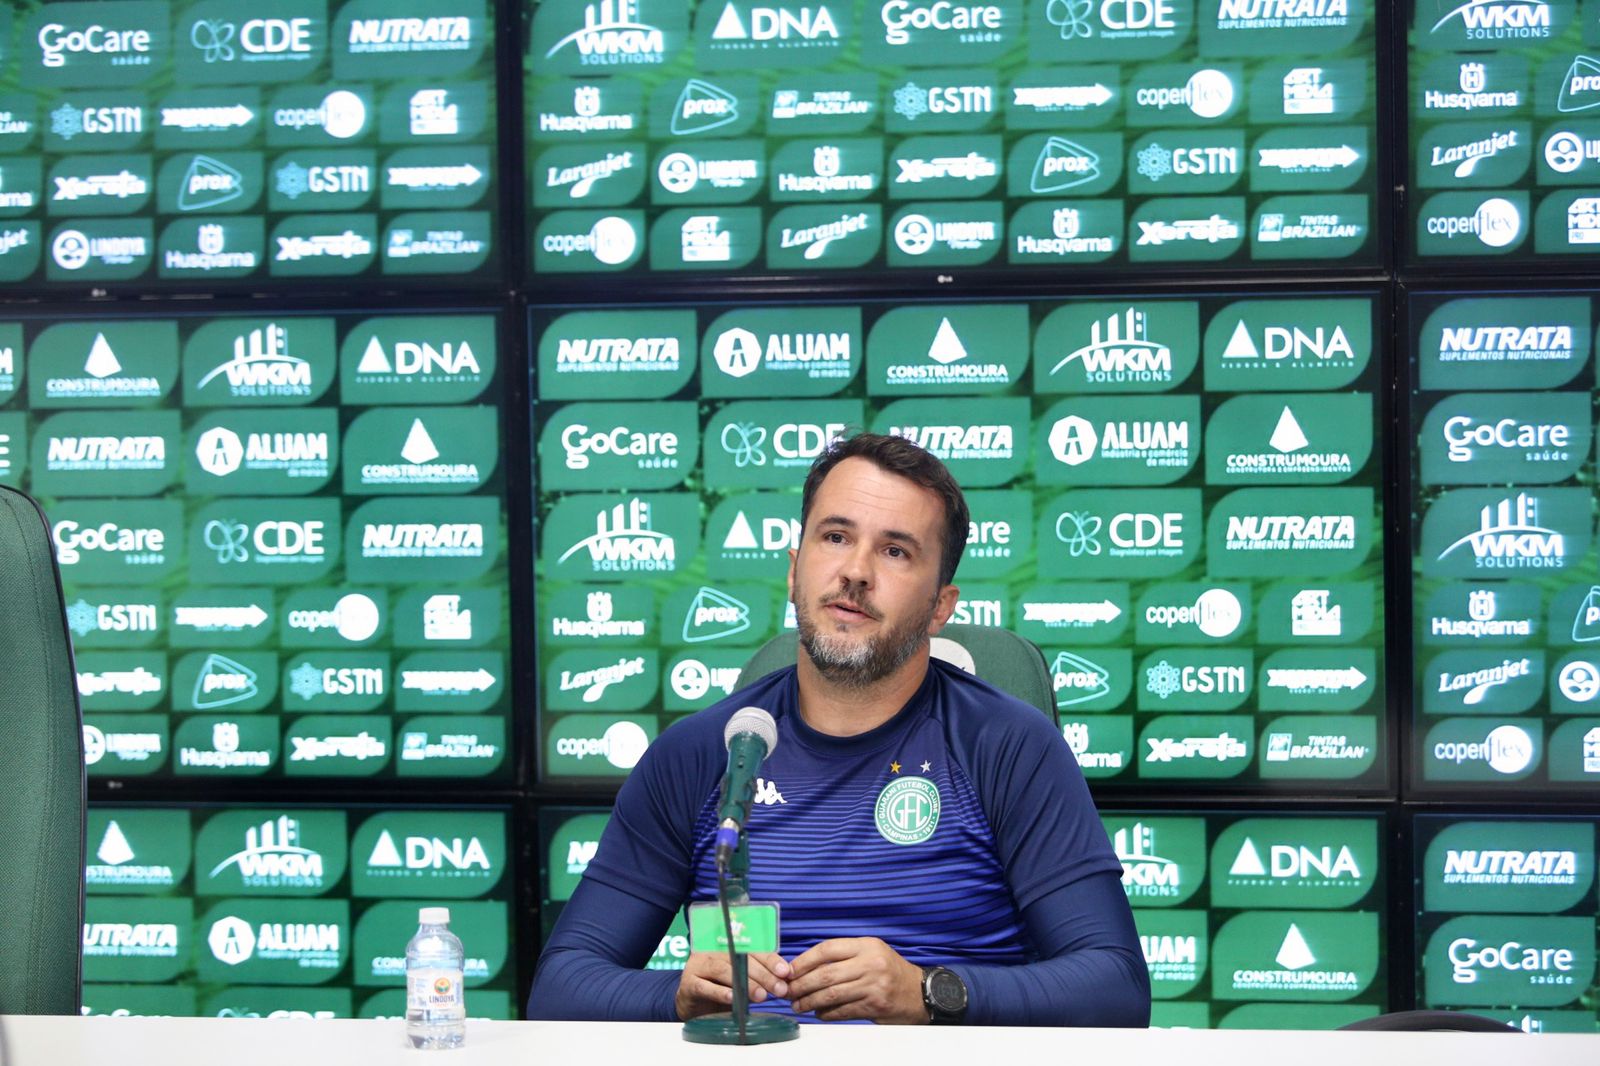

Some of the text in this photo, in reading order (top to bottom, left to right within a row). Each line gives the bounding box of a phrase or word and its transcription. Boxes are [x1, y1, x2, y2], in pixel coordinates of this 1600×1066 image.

[882, 0, 1001, 44] GoCare
[1101, 0, 1175, 29] CDE
[1219, 0, 1347, 20] NUTRATA
[1460, 4, 1550, 27] WKM
[350, 17, 470, 43] NUTRATA
[752, 7, 838, 40] DNA
[1218, 16, 1346, 29] SUPLEMENTOS NUTRICIONAIS
[1466, 26, 1549, 39] SOLUTIONS
[39, 24, 150, 67] GoCare
[241, 18, 310, 52] CDE
[576, 29, 663, 54] WKM
[581, 52, 663, 64] SOLUTIONS
[1570, 76, 1600, 95] pro
[683, 99, 729, 118] prox
[796, 100, 869, 115] BRAZILIAN
[929, 87, 991, 113] GSTN
[1426, 90, 1518, 110] Husqvarna
[83, 107, 141, 133] GSTN
[541, 112, 632, 132] Husqvarna
[1044, 156, 1089, 176] prox
[1173, 148, 1237, 174] GSTN
[1432, 131, 1517, 177] Laranjet
[309, 166, 368, 192] GSTN
[548, 152, 632, 198] Laranjet
[779, 173, 873, 192] Husqvarna
[1281, 224, 1357, 238] BRAZILIAN
[1301, 215, 1338, 227] TINTAS
[1427, 209, 1512, 238] coperflex
[411, 239, 480, 254] BRAZILIAN
[781, 213, 867, 259] Laranjet
[1018, 235, 1112, 254] Husqvarna
[166, 249, 255, 269] Husqvarna
[766, 333, 850, 361] ALUAM
[1265, 326, 1353, 359] DNA
[1440, 326, 1571, 350] NUTRATA
[396, 342, 480, 374] DNA
[557, 338, 679, 363] NUTRATA
[1080, 347, 1171, 372] WKM
[1440, 350, 1571, 360] SUPLEMENTOS NUTRICIONAIS
[225, 361, 311, 386] WKM
[887, 365, 1008, 380] CONSTRUMOURA
[1086, 370, 1171, 382] SOLUTIONS
[47, 377, 159, 393] CONSTRUMOURA
[246, 433, 327, 460] ALUAM
[562, 425, 677, 469] GoCare
[1102, 422, 1188, 449] ALUAM
[1444, 416, 1568, 461] GoCare
[48, 437, 164, 460] NUTRATA
[1527, 451, 1568, 460] saúde
[362, 462, 478, 479] CONSTRUMOURA
[1227, 454, 1350, 468] CONSTRUMOURA
[254, 521, 324, 554] CDE
[363, 524, 483, 548] NUTRATA
[966, 521, 1011, 544] are
[1110, 513, 1183, 547] CDE
[1227, 516, 1354, 540] NUTRATA
[53, 521, 164, 564] GoCare
[587, 537, 675, 562] WKM
[1227, 539, 1354, 549] SUPLEMENTOS NUTRICIONAIS
[1469, 533, 1564, 557] WKM
[593, 560, 674, 571] SOLUTIONS
[1476, 556, 1563, 567] SOLUTIONS
[97, 605, 156, 631] GSTN
[947, 600, 1001, 627] STN
[553, 616, 644, 638] Husqvarna
[1432, 616, 1530, 637] Husqvarna
[323, 668, 383, 694] GSTN
[1182, 667, 1244, 693] GSTN
[1439, 659, 1529, 704] Laranjet
[1290, 744, 1364, 758] BRAZILIAN
[1309, 736, 1346, 747] TINTAS
[237, 852, 322, 877] WKM
[406, 837, 490, 869] DNA
[1271, 846, 1360, 878] DNA
[1444, 851, 1575, 875] NUTRATA
[1444, 874, 1574, 884] SUPLEMENTOS NUTRICIONAIS
[83, 924, 178, 947] UTRATA
[258, 924, 338, 951] ALUAM
[1140, 936, 1195, 963] UAM
[1449, 938, 1573, 983] GoCare
[1234, 969, 1357, 985] CONSTRUMOURA
[1531, 975, 1572, 984] saúde
